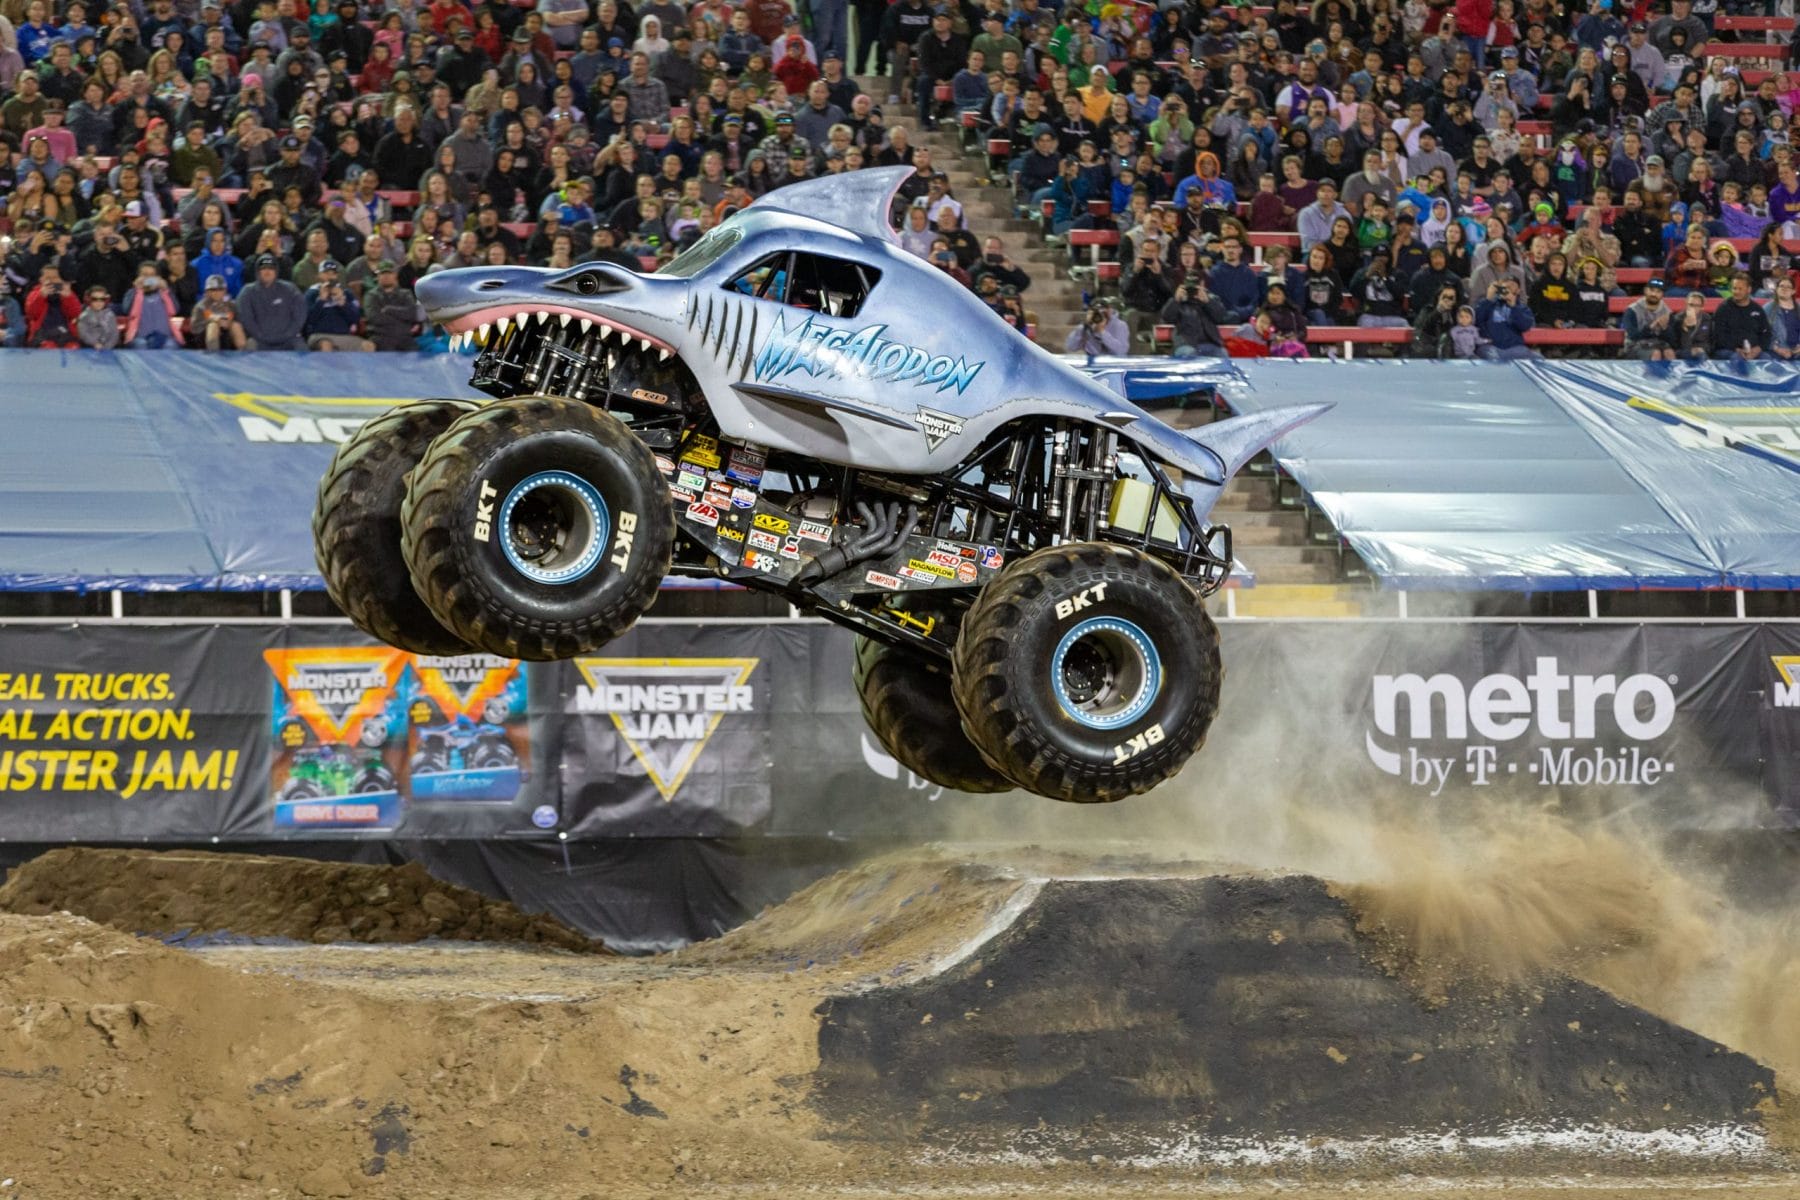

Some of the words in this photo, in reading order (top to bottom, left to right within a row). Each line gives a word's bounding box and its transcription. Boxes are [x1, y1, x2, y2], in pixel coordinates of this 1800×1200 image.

[755, 308, 986, 396] MEGALODON
[916, 413, 963, 434] MONSTER
[927, 426, 948, 438] JAM
[473, 479, 499, 543] BKT
[611, 510, 638, 573] BKT
[716, 525, 746, 542] UNOH
[910, 560, 954, 578] MAGNAFLOW
[929, 552, 960, 567] MSD
[868, 573, 898, 589] SIMPSON
[1055, 582, 1108, 620] BKT
[54, 673, 175, 700] TRUCKS.
[288, 673, 387, 690] MONSTER
[442, 668, 485, 682] JAM
[317, 689, 361, 704] JAM
[576, 684, 754, 712] MONSTER
[1373, 656, 1676, 742] metro
[43, 708, 195, 740] ACTION.
[628, 713, 705, 740] JAM
[1113, 723, 1166, 766] BKT
[120, 750, 239, 799] JAM!
[1408, 748, 1456, 796] by
